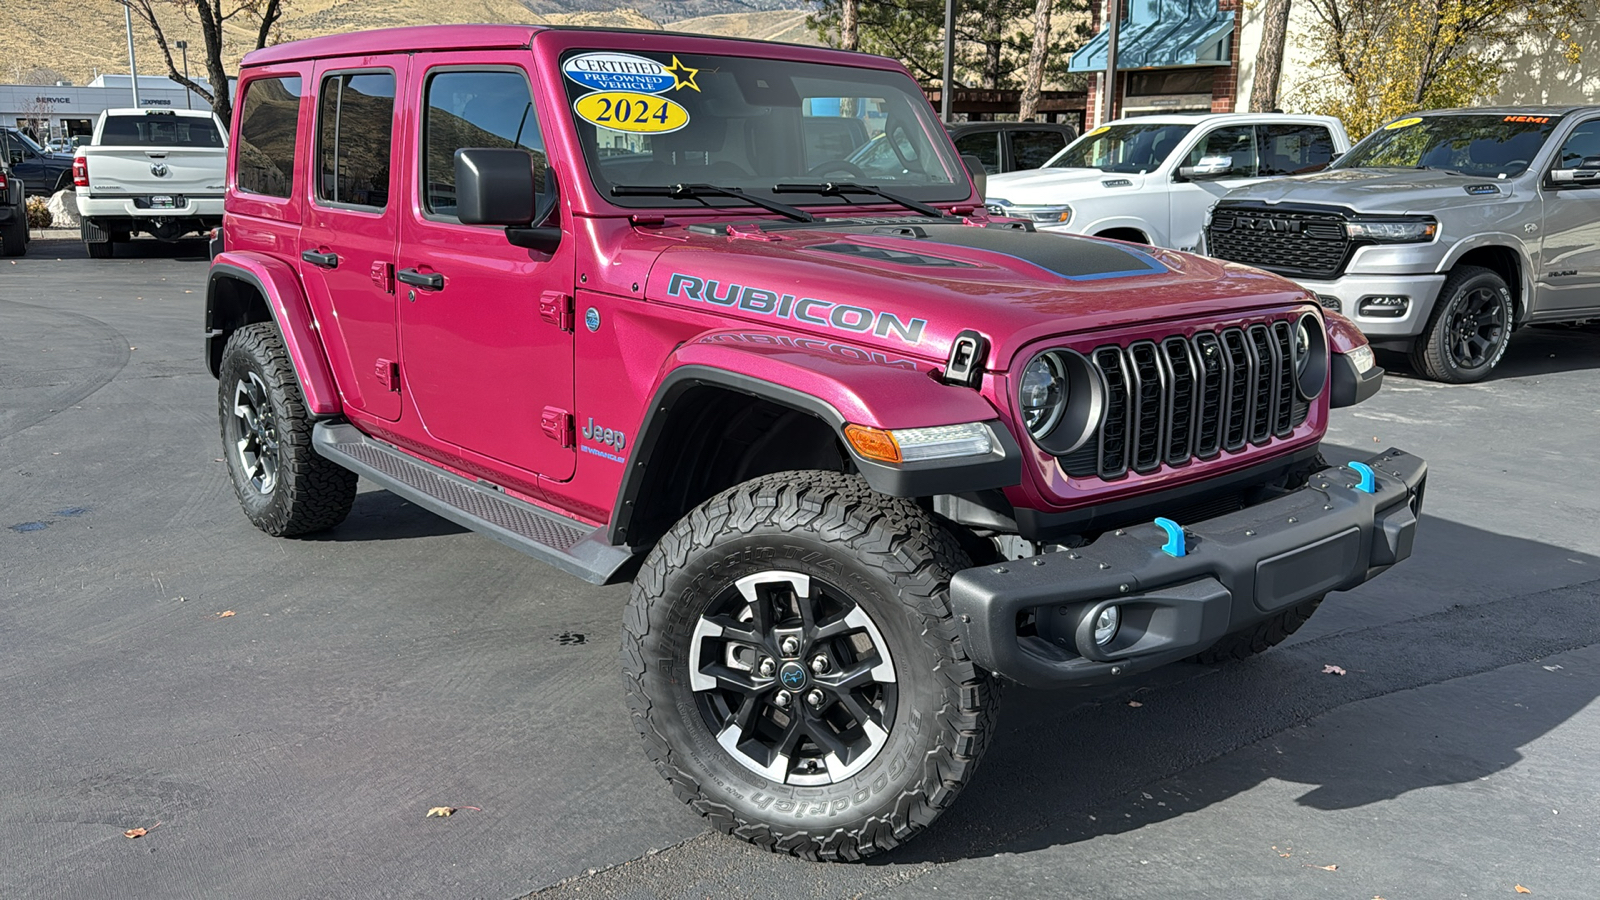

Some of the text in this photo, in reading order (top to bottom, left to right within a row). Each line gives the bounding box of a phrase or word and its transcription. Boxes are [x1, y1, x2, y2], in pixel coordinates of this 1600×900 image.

[574, 58, 662, 75] CERTIFIED
[584, 73, 662, 84] PRE-OWNED
[598, 81, 656, 91] VEHICLE
[596, 98, 669, 124] 2024
[1503, 115, 1549, 124] HEMI
[1236, 217, 1301, 232] RAM
[667, 272, 928, 344] RUBICON
[582, 417, 627, 453] Jeep
[658, 546, 776, 673] All-Terrain
[750, 703, 923, 819] BFGoodrich
